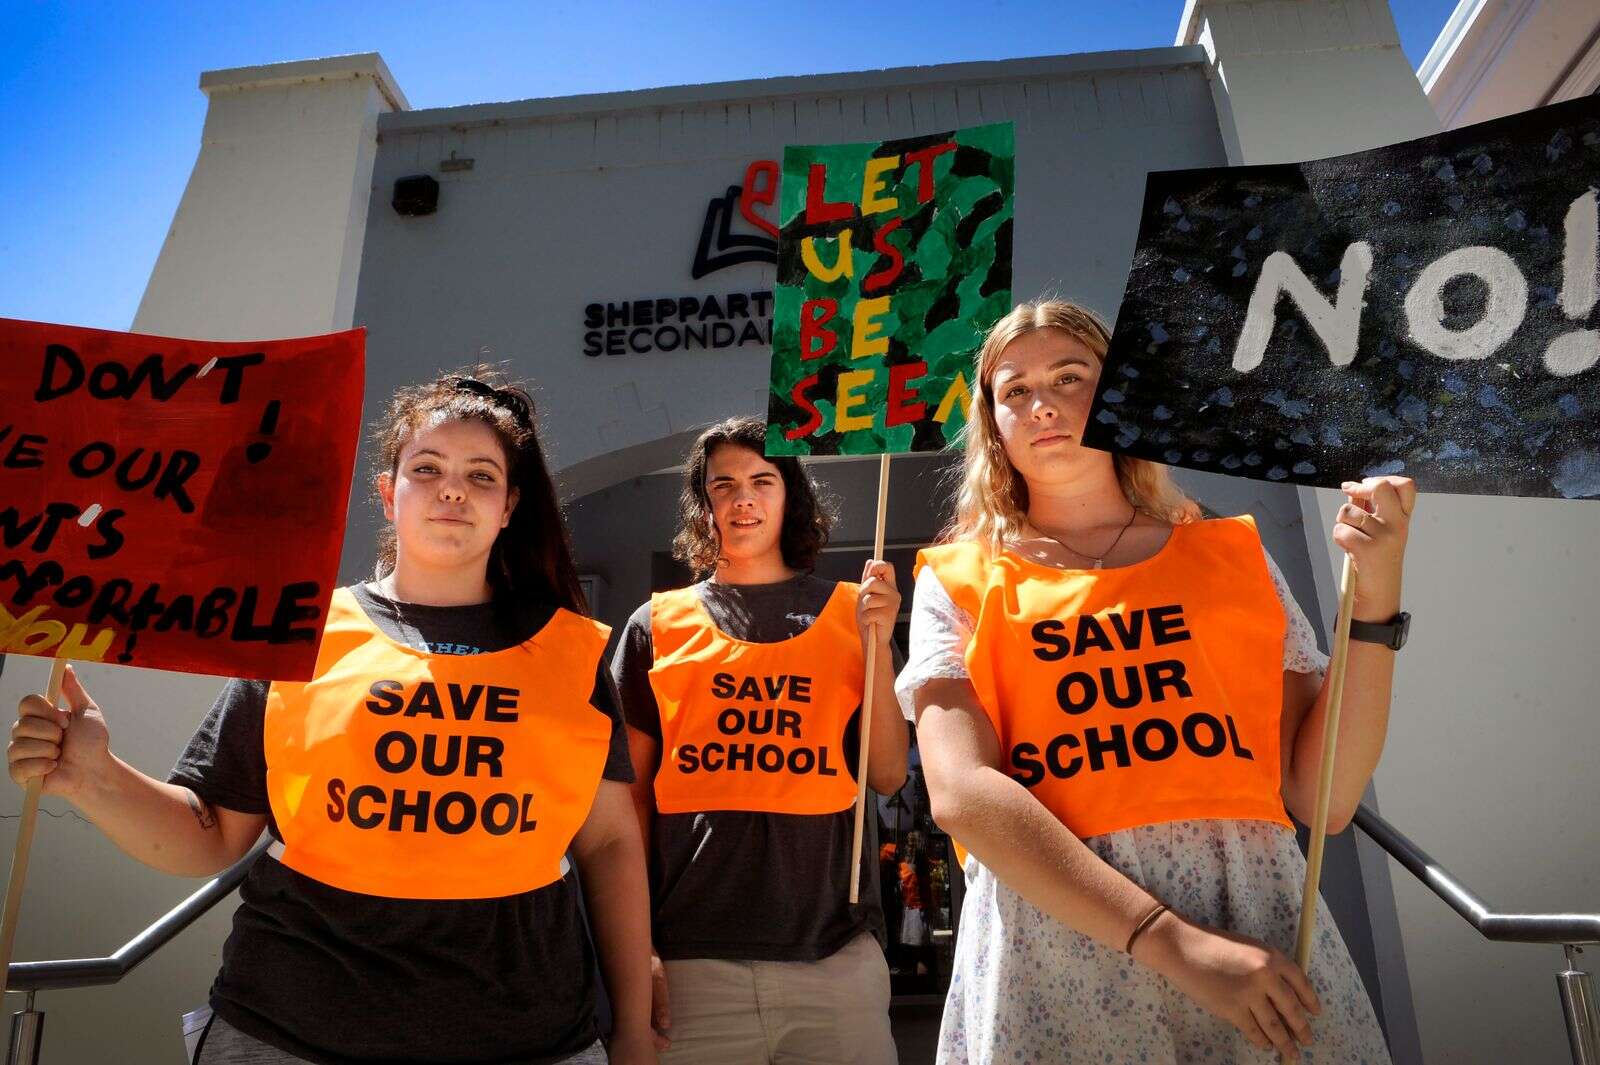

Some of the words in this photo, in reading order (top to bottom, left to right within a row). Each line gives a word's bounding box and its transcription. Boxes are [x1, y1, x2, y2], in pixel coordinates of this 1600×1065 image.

[806, 141, 957, 225] LET
[800, 219, 903, 292] US
[1231, 184, 1600, 377] NO!
[583, 290, 775, 329] SHEPPART
[583, 318, 773, 357] SECONDA
[800, 297, 891, 361] BE
[35, 344, 265, 403] DON'T
[68, 441, 200, 514] OUR
[1031, 604, 1192, 662] SAVE
[365, 680, 520, 723] SAVE
[711, 672, 812, 704] SAVE
[1056, 659, 1193, 715] OUR
[717, 708, 802, 738] OUR
[1010, 712, 1255, 788] SCHOOL
[374, 730, 505, 778] OUR
[678, 742, 838, 777] SCHOOL
[326, 778, 537, 836] SCHOOL
